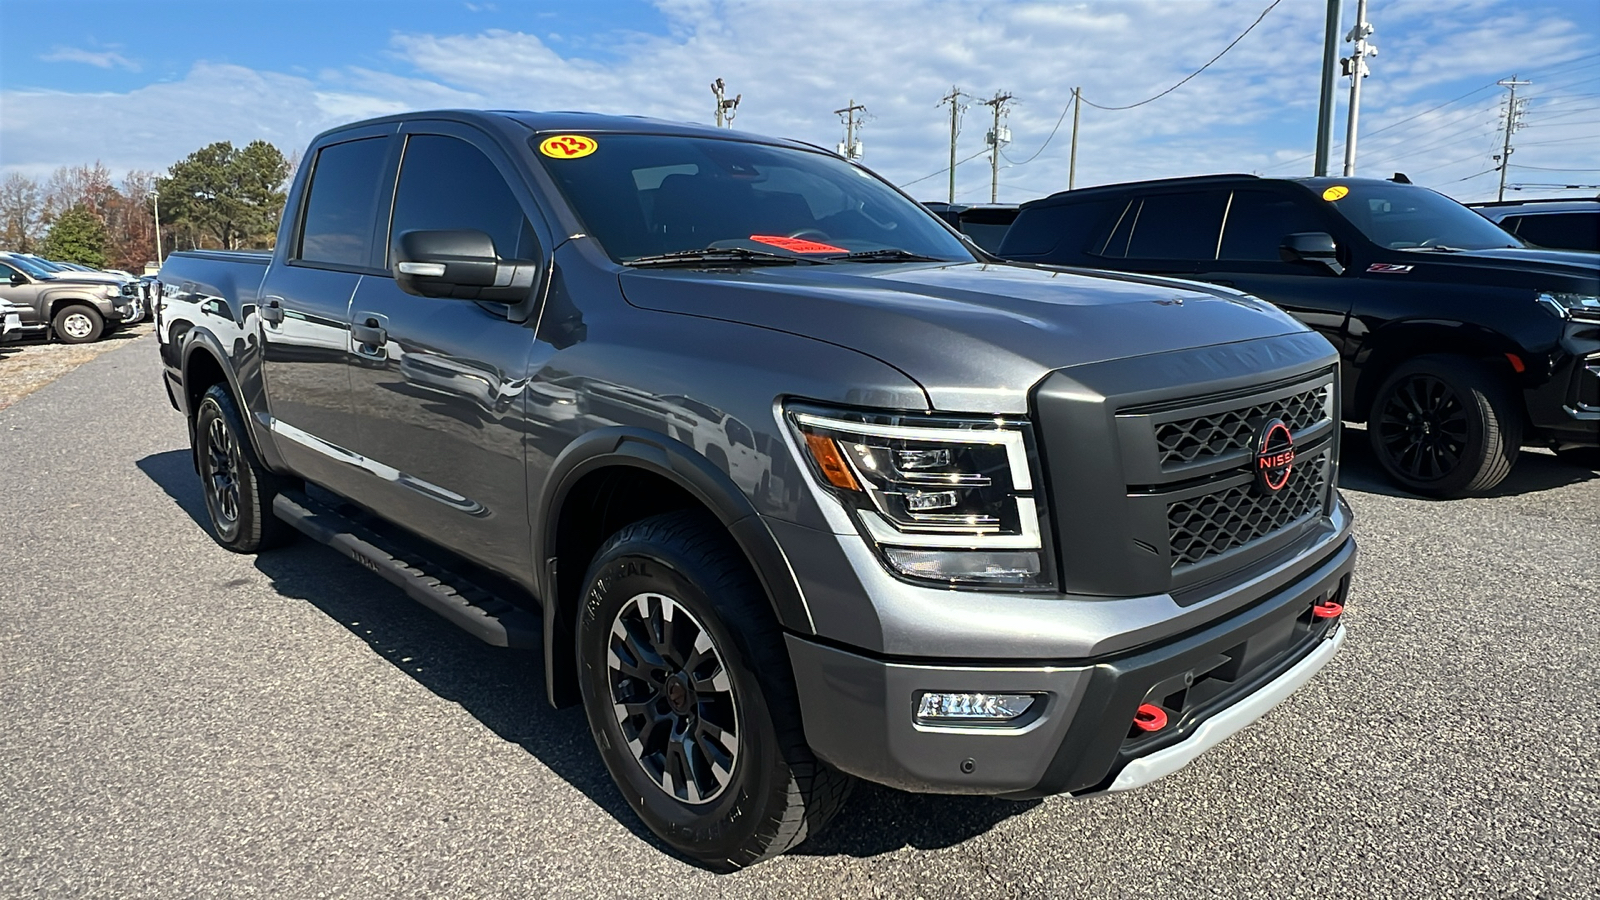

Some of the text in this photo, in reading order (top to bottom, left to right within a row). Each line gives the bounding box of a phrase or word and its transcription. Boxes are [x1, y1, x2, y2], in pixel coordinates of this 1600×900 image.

[550, 136, 588, 156] 23
[1366, 263, 1415, 274] Z71
[1259, 451, 1295, 469] NISSA
